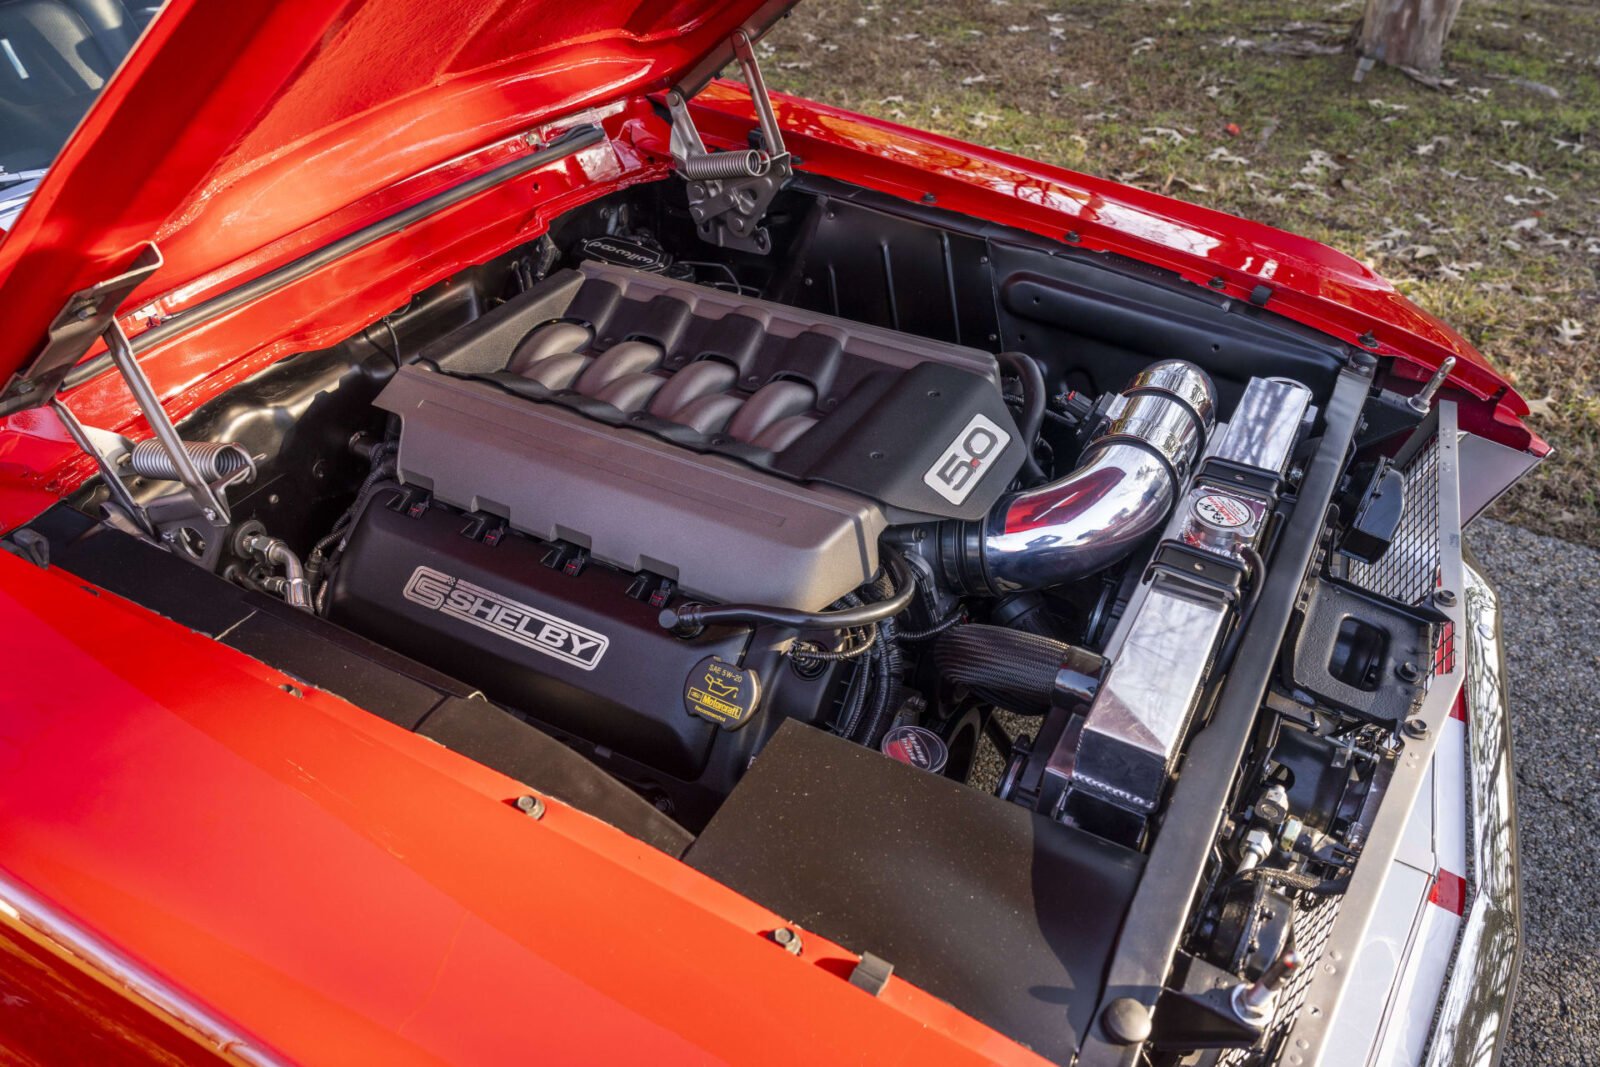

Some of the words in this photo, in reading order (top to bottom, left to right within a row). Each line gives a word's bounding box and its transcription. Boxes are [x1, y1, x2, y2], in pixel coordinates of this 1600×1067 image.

[588, 241, 654, 264] wilwood
[936, 427, 998, 491] 5.0
[446, 589, 602, 656] SHELBY
[708, 664, 722, 675] SAE
[701, 694, 740, 717] Motorcraft
